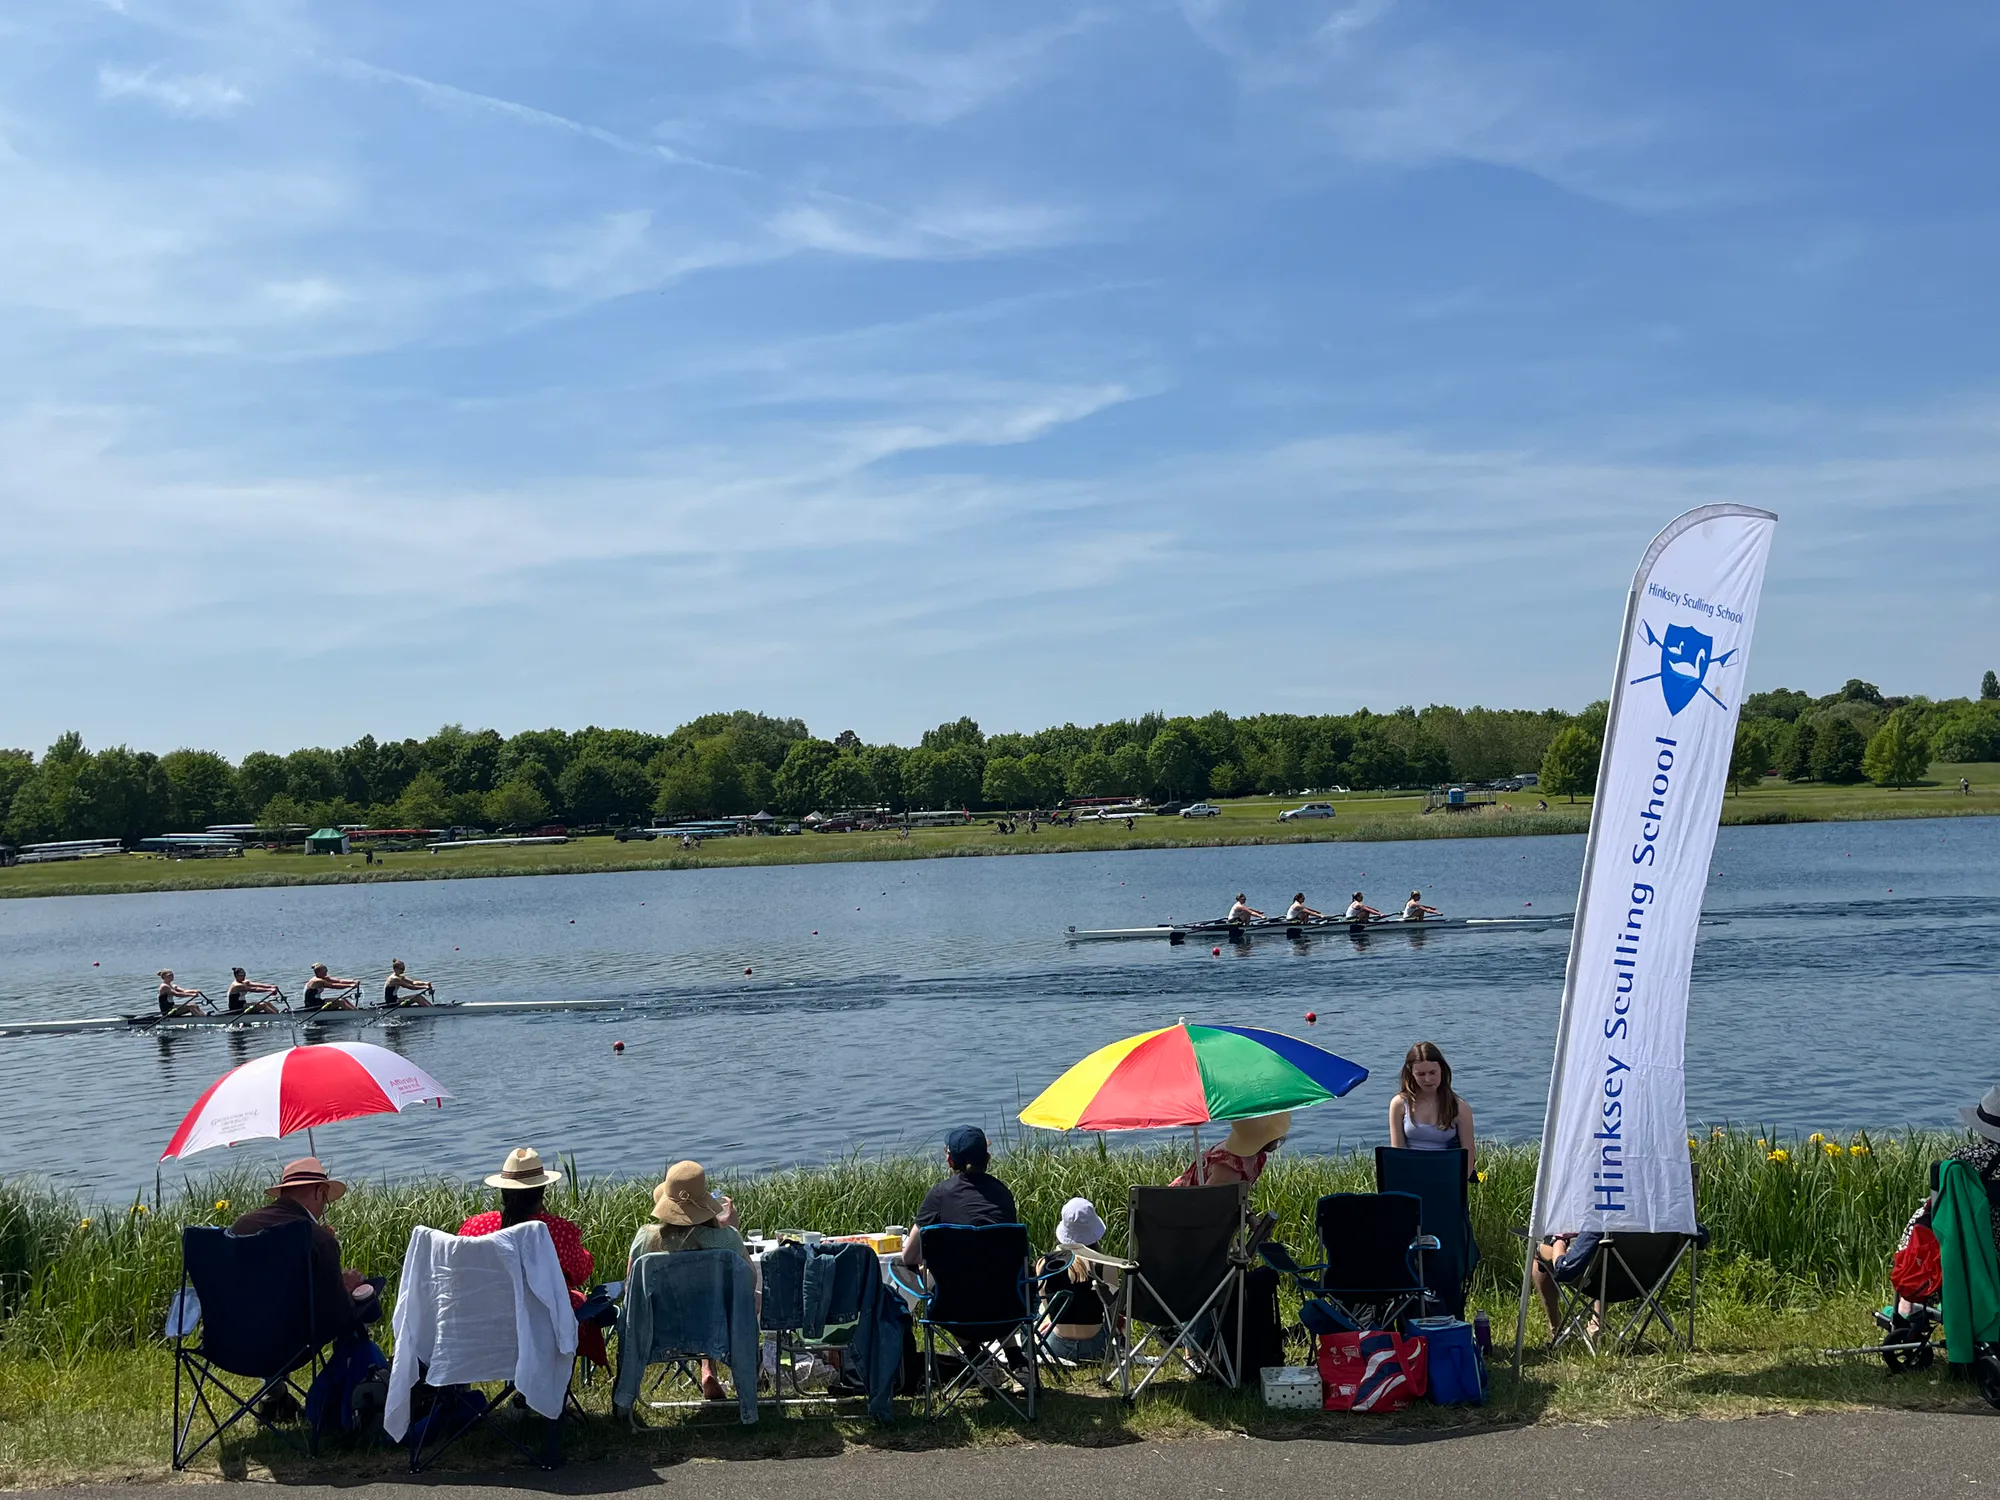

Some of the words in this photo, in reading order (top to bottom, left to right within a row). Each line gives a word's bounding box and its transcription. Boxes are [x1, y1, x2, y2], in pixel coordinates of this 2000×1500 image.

[1648, 582, 1681, 606] Hinksey
[1682, 593, 1715, 618] Sculling
[1716, 604, 1744, 624] School
[1632, 736, 1678, 866] School
[1604, 882, 1655, 1040] Sculling
[389, 1076, 419, 1087] Affinity
[1594, 1055, 1632, 1211] Hinksey
